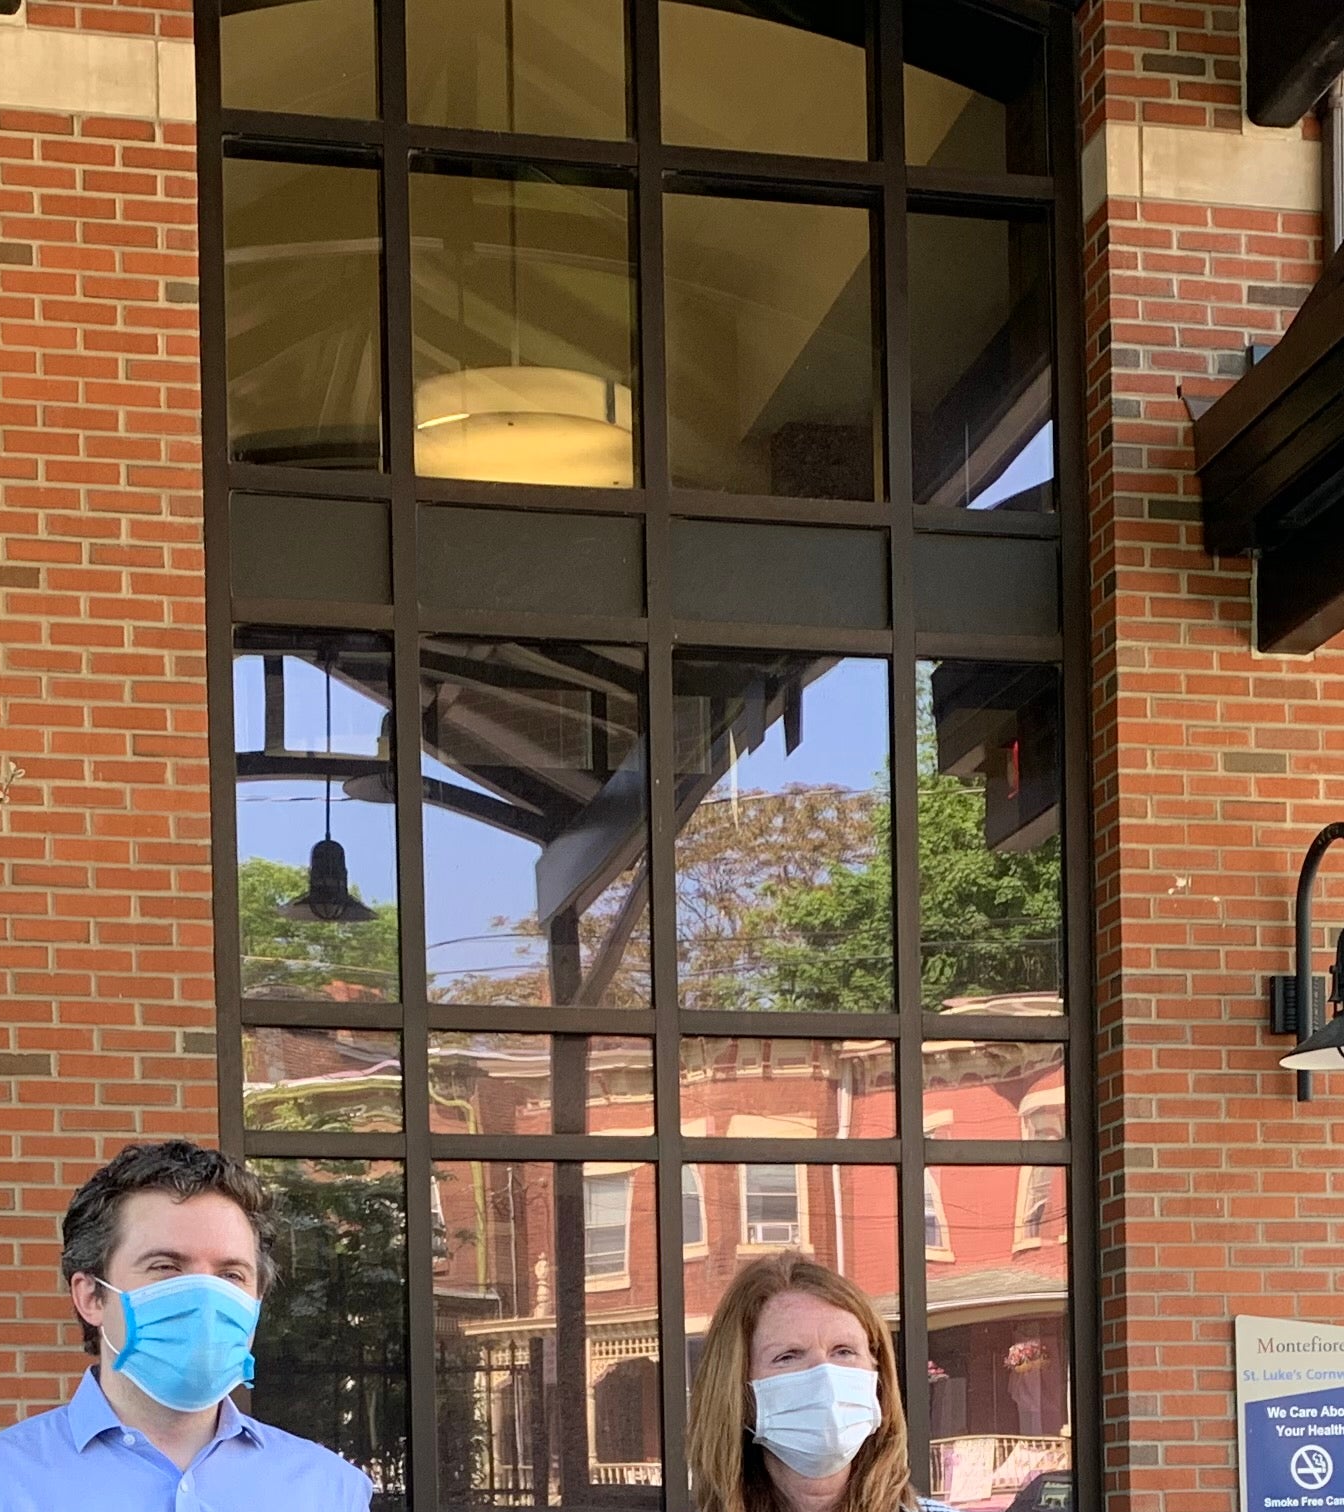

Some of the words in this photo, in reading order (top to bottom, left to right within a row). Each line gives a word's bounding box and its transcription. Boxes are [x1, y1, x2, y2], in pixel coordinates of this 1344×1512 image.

[1243, 1370, 1259, 1381] St.
[1263, 1369, 1302, 1381] Luke's
[1267, 1407, 1287, 1418] We
[1289, 1406, 1318, 1418] Care
[1276, 1425, 1305, 1437] Your
[1264, 1496, 1299, 1507] Smoke
[1301, 1496, 1323, 1507] Free
